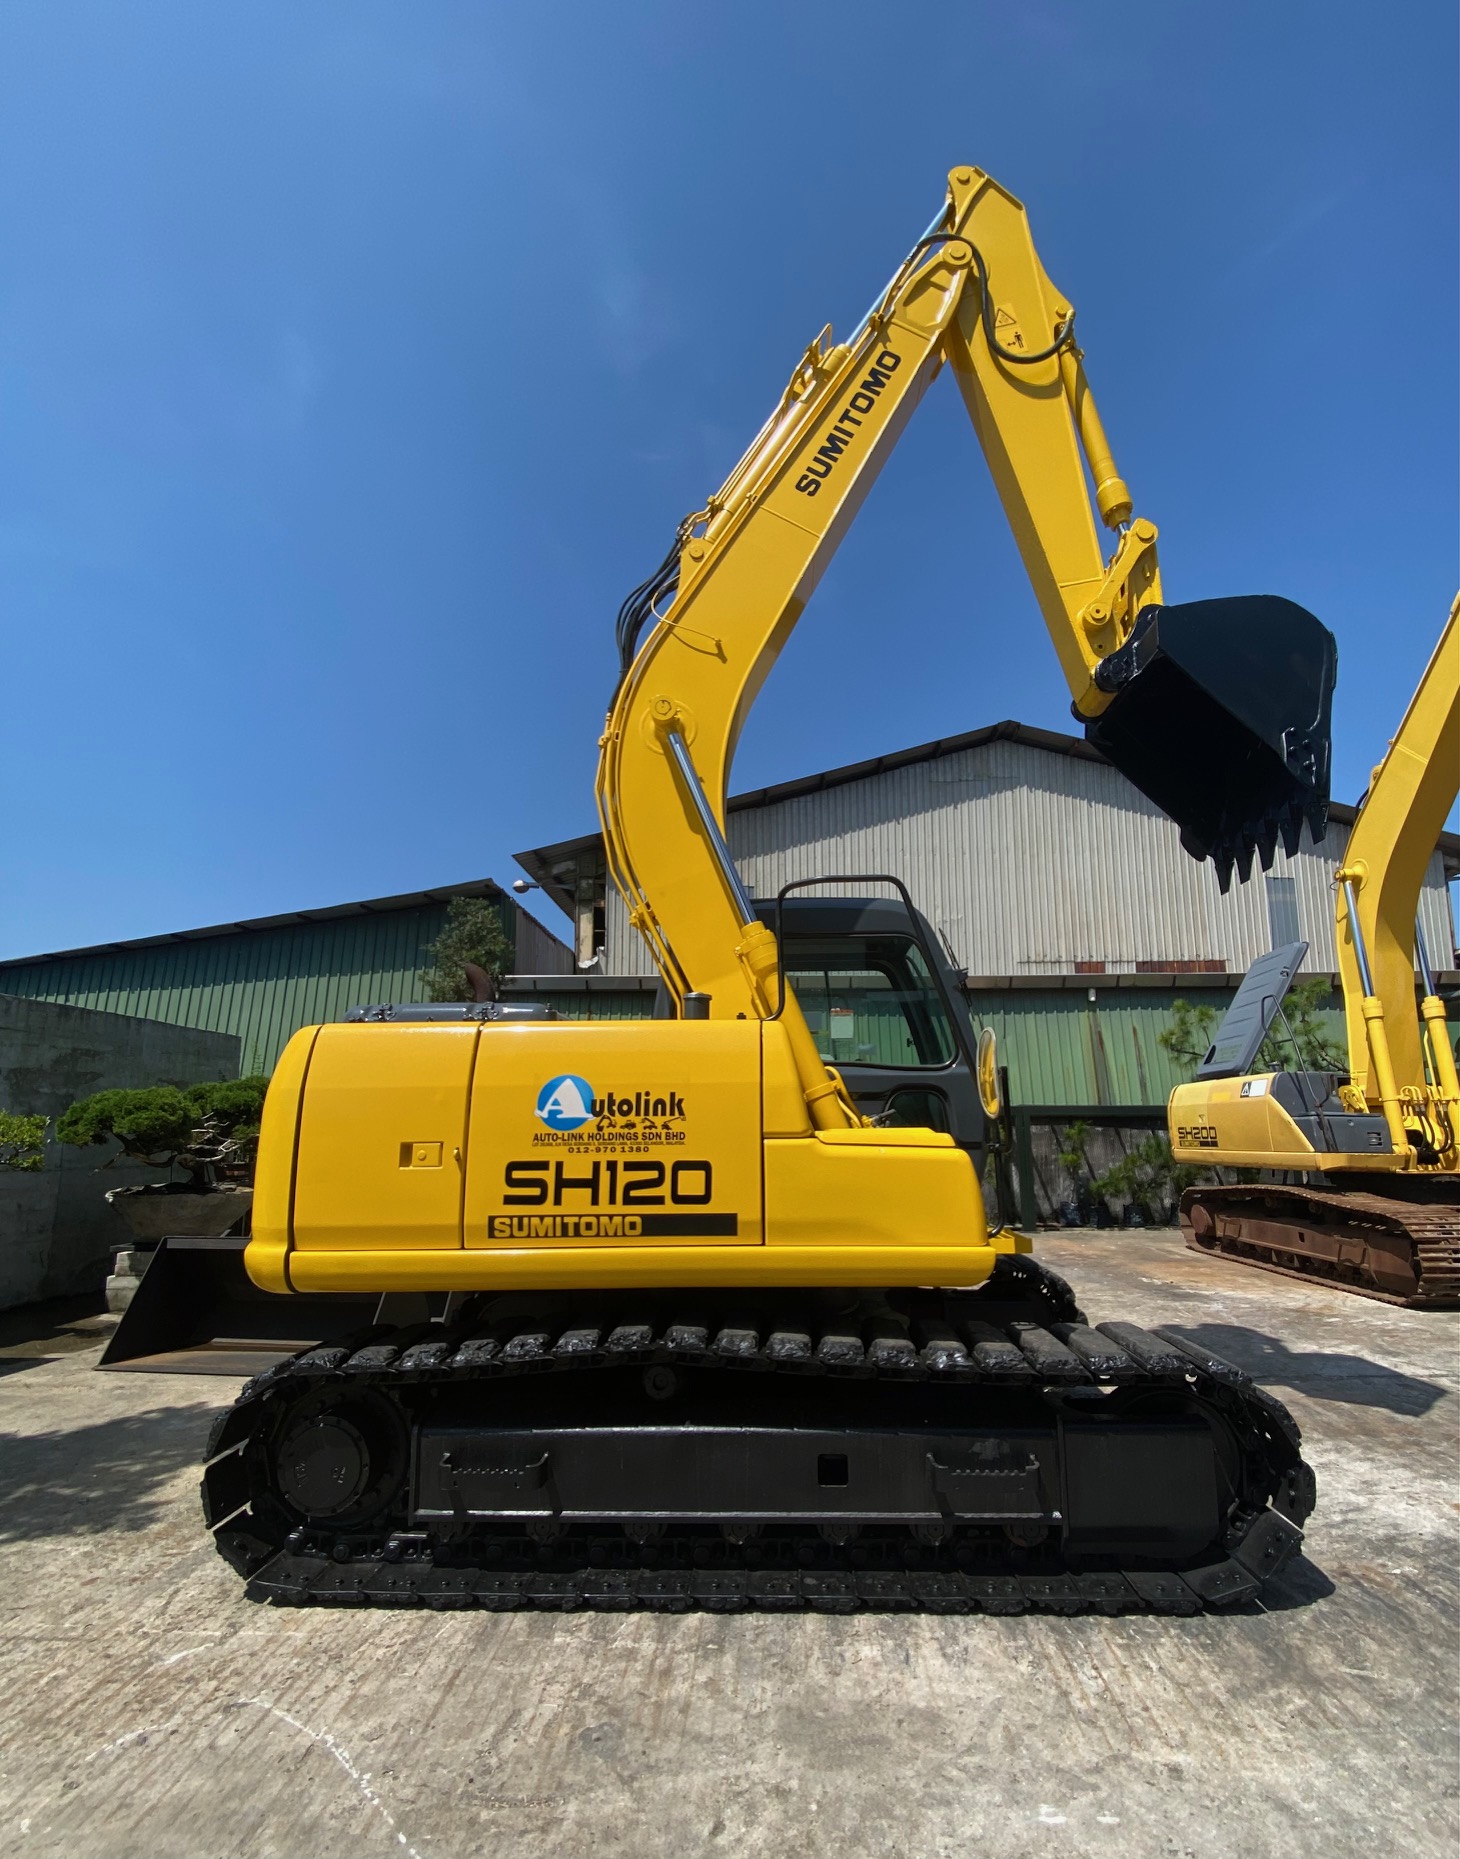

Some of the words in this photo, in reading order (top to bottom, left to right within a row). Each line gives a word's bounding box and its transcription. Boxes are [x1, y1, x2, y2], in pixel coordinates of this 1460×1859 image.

[795, 350, 902, 497] SUMITOMO
[534, 1077, 687, 1120] Autolink
[532, 1132, 585, 1142] AUTO-LINK
[587, 1132, 639, 1142] HOLDINGS
[641, 1131, 662, 1141] SDN
[665, 1131, 686, 1141] BHD
[1178, 1126, 1217, 1140] SH200
[568, 1146, 616, 1154] 012-970
[620, 1145, 650, 1153] 1380
[503, 1160, 712, 1206] SH120
[493, 1215, 643, 1238] SUMITOMO
